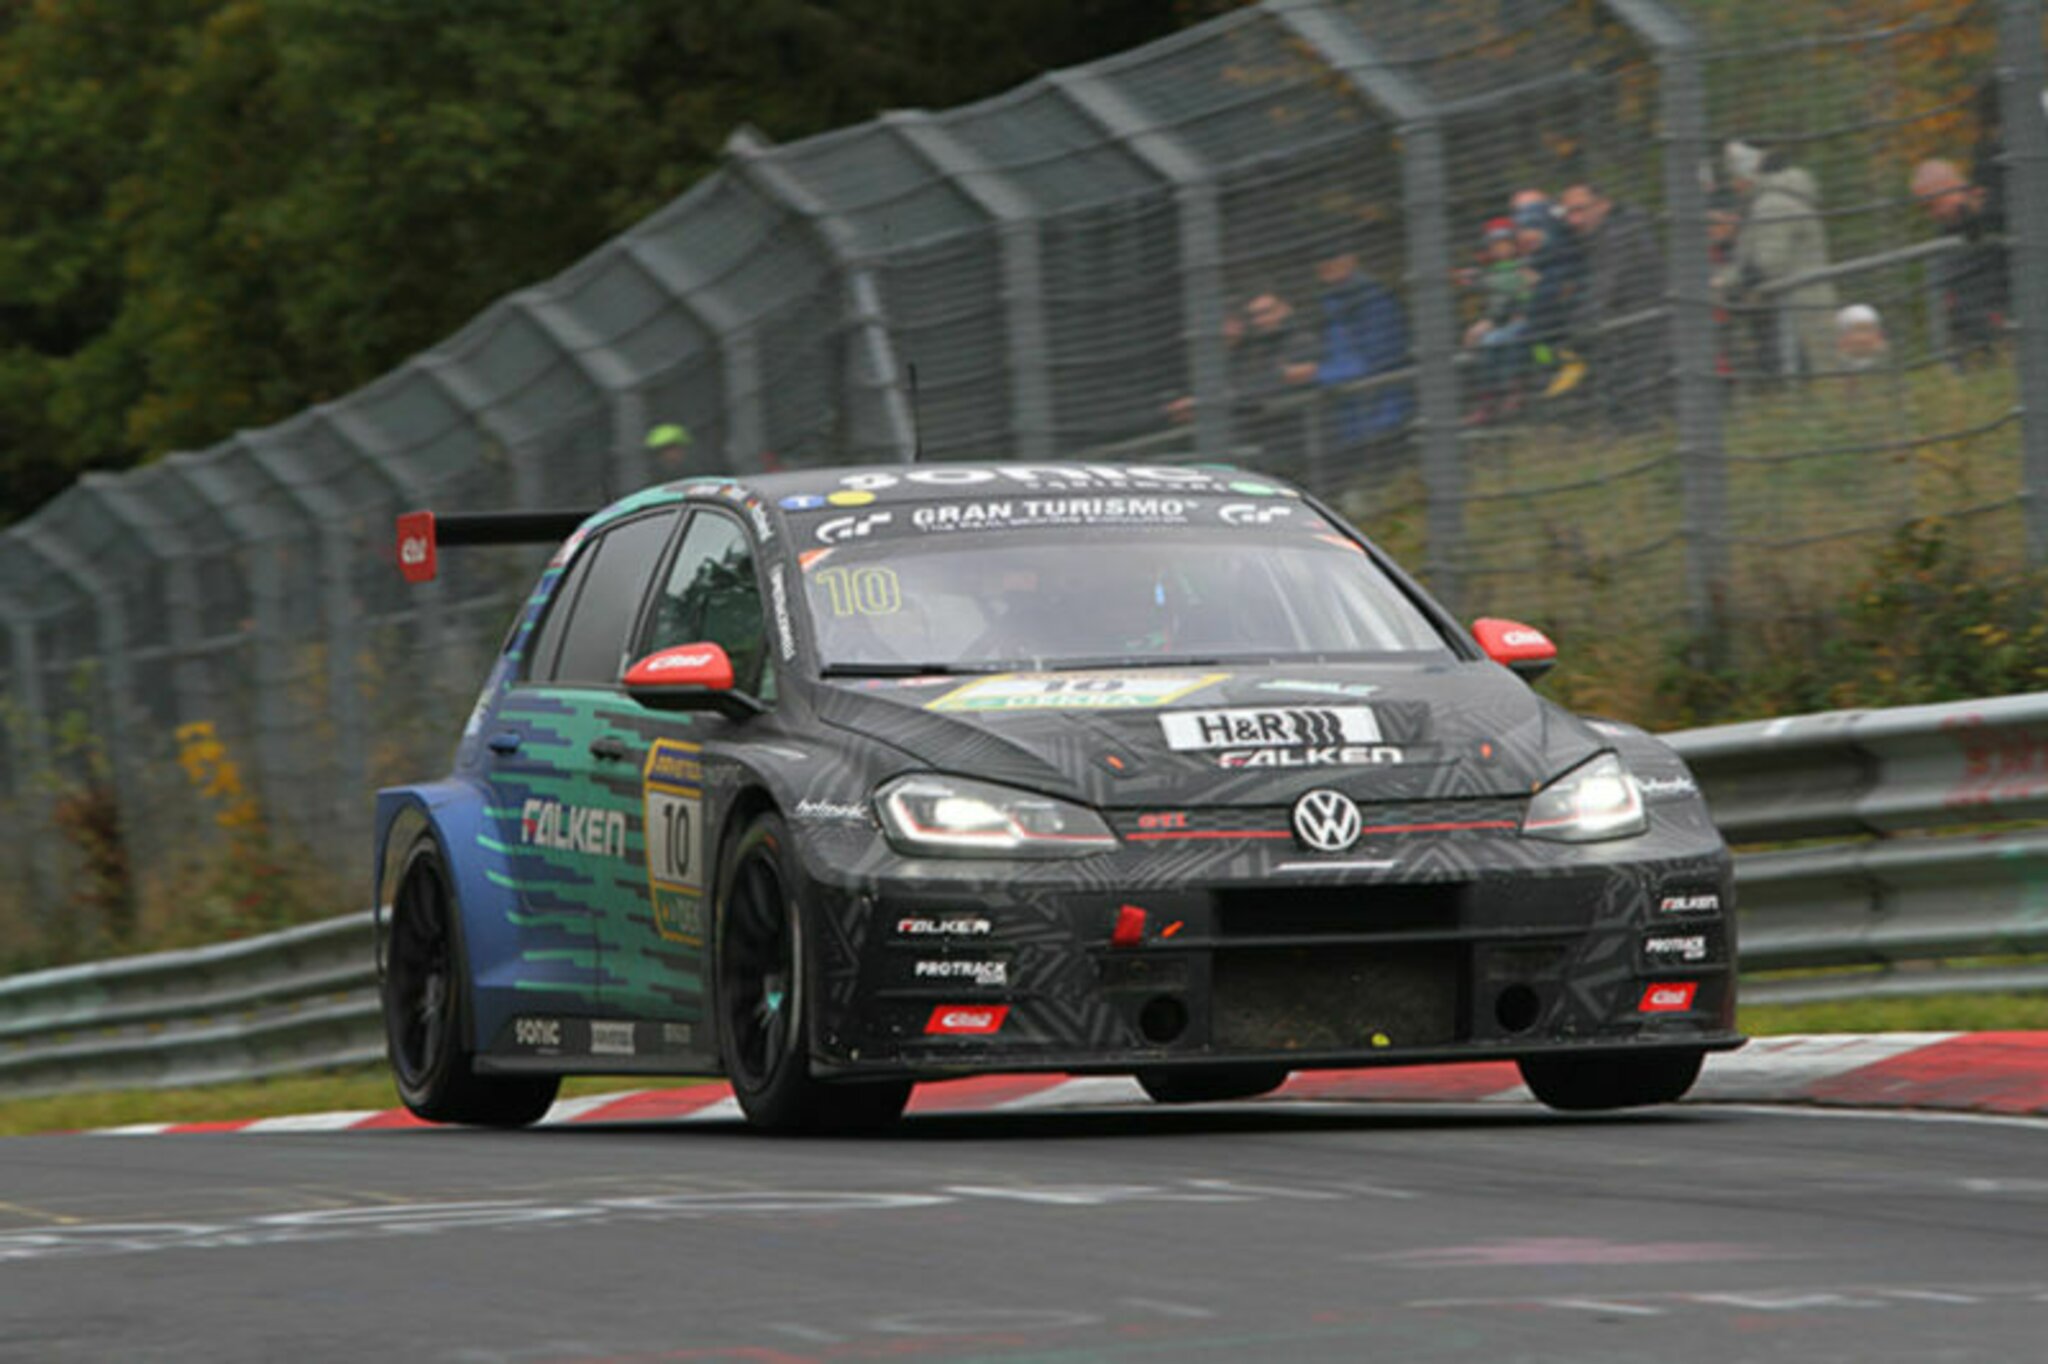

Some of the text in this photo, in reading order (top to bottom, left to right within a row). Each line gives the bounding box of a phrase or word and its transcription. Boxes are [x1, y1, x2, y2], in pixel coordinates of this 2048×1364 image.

[912, 501, 1012, 526] GRAN
[815, 566, 901, 618] 10
[1199, 714, 1288, 744] H&R
[1218, 747, 1403, 769] FALKEN
[522, 799, 626, 857] FALKEN
[1137, 812, 1188, 829] GTI
[663, 802, 691, 877] 10
[897, 917, 991, 934] FALKEN
[915, 960, 1008, 977] PROTRACK
